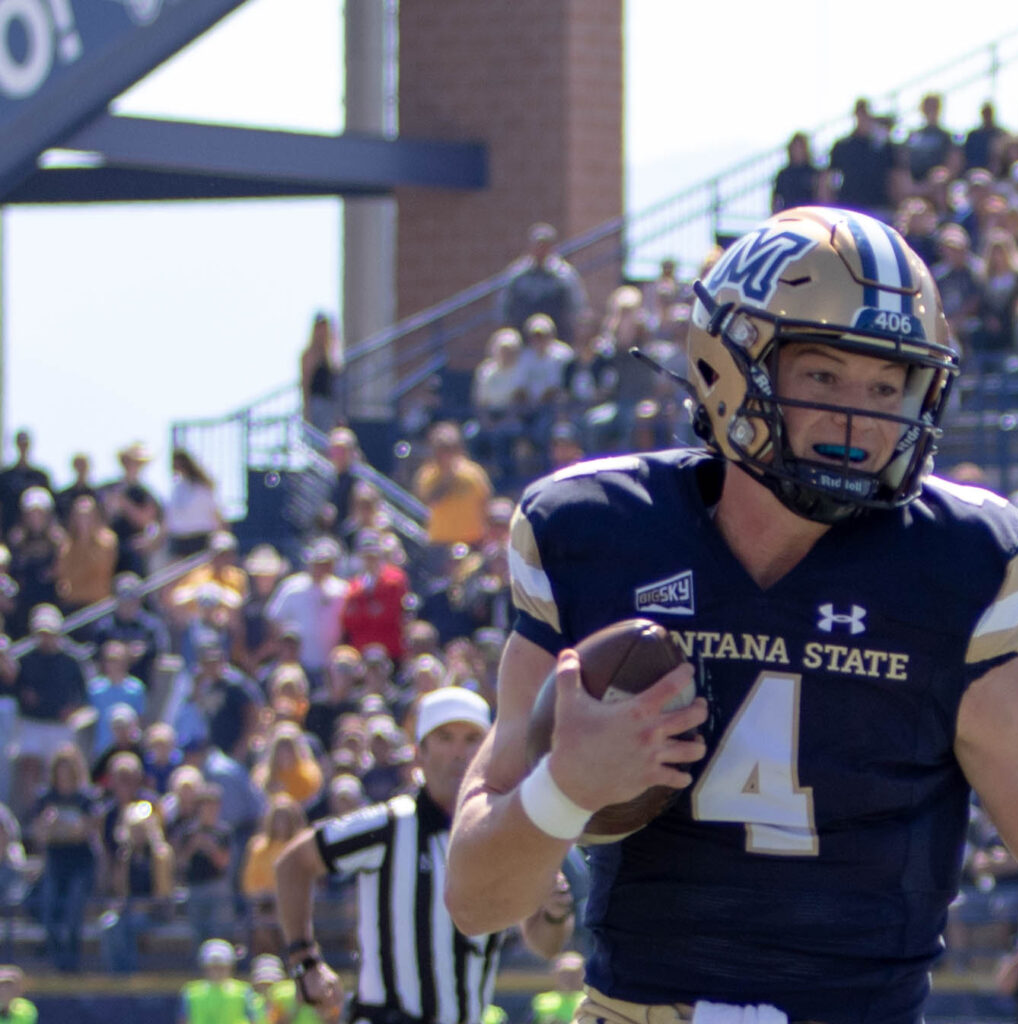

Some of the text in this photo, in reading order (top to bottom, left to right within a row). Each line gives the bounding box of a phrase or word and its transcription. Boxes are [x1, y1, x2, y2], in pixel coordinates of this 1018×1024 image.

[698, 228, 820, 307] M
[875, 312, 913, 335] 406
[670, 630, 909, 680] NTANA STATE
[692, 670, 820, 857] 4
